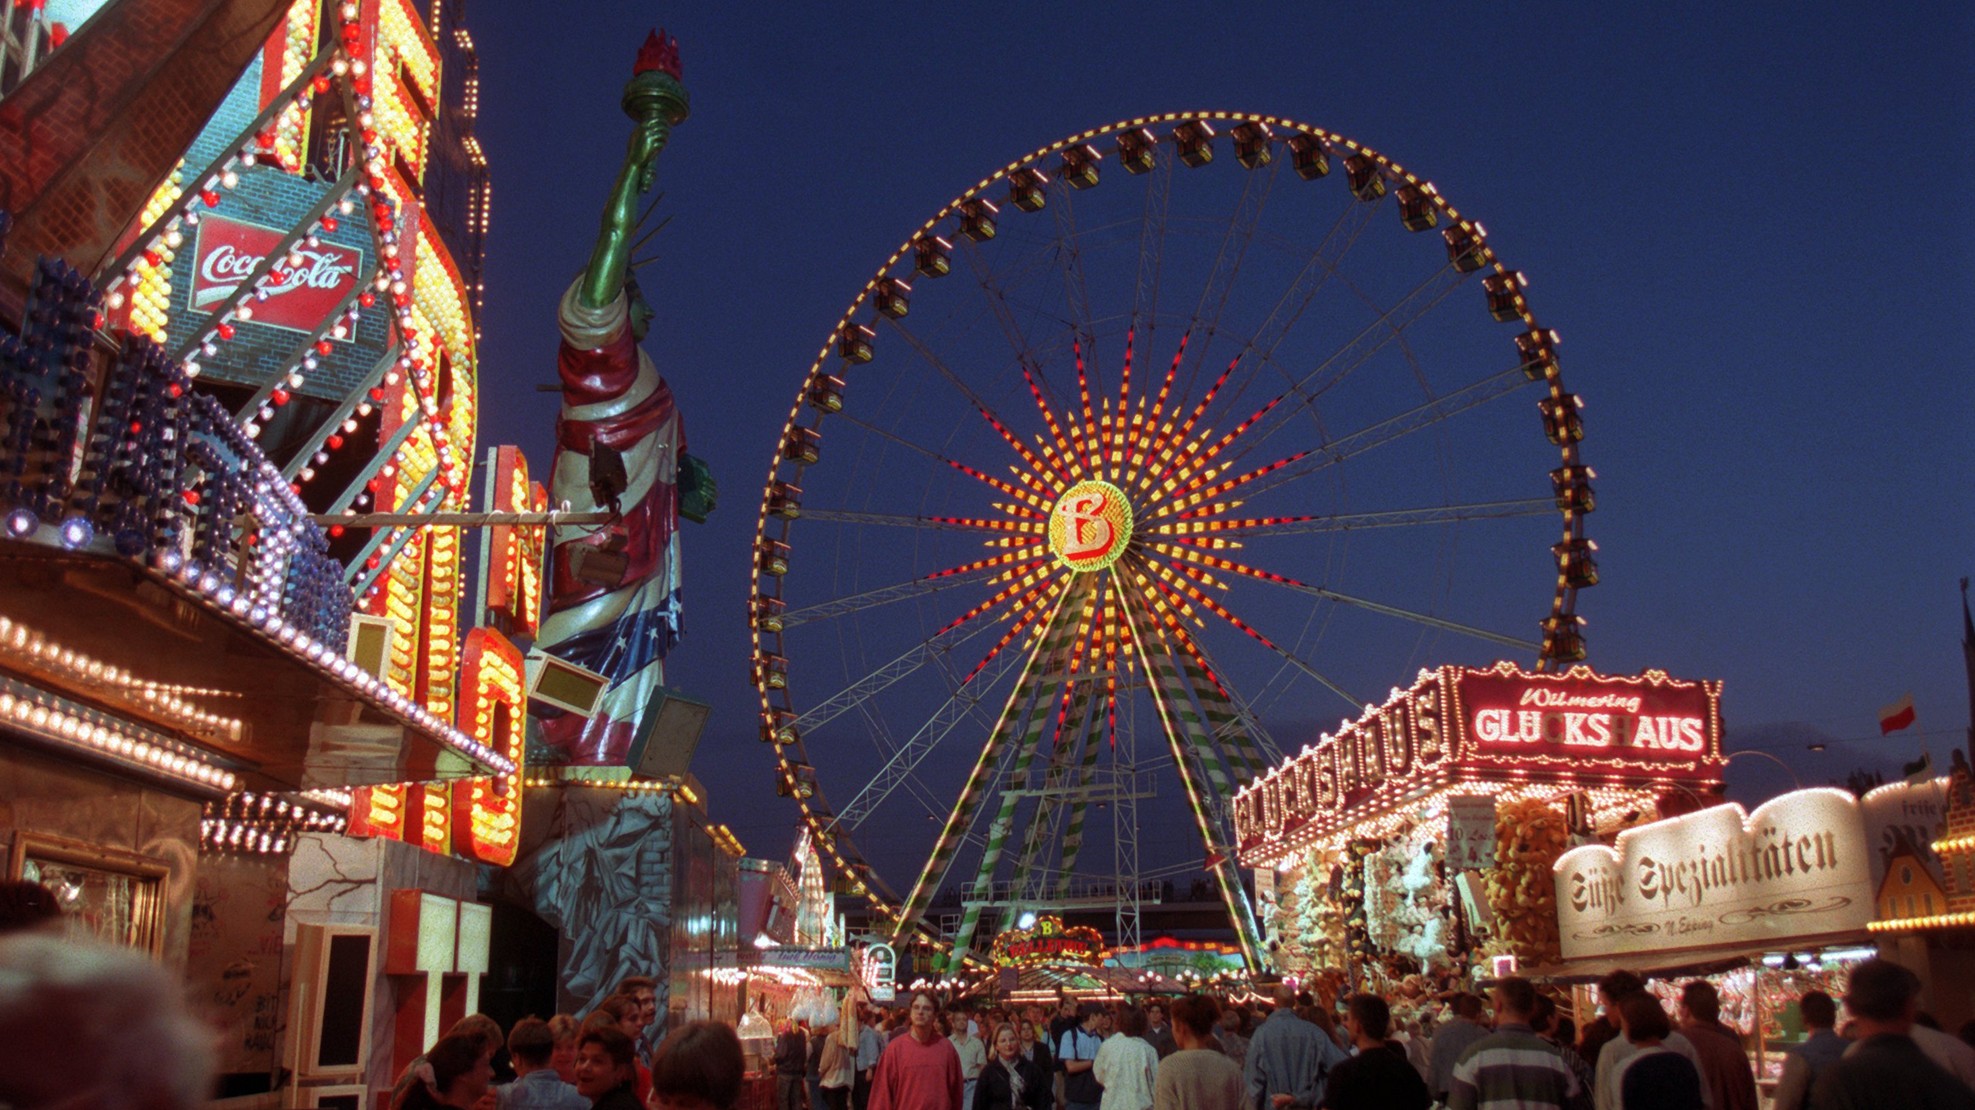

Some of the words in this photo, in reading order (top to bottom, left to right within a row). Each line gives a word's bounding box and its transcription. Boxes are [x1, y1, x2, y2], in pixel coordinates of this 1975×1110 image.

[1058, 492, 1115, 562] B
[1519, 687, 1642, 713] Wilmering
[1638, 826, 1838, 907] Spezialitäten
[1041, 920, 1053, 935] B
